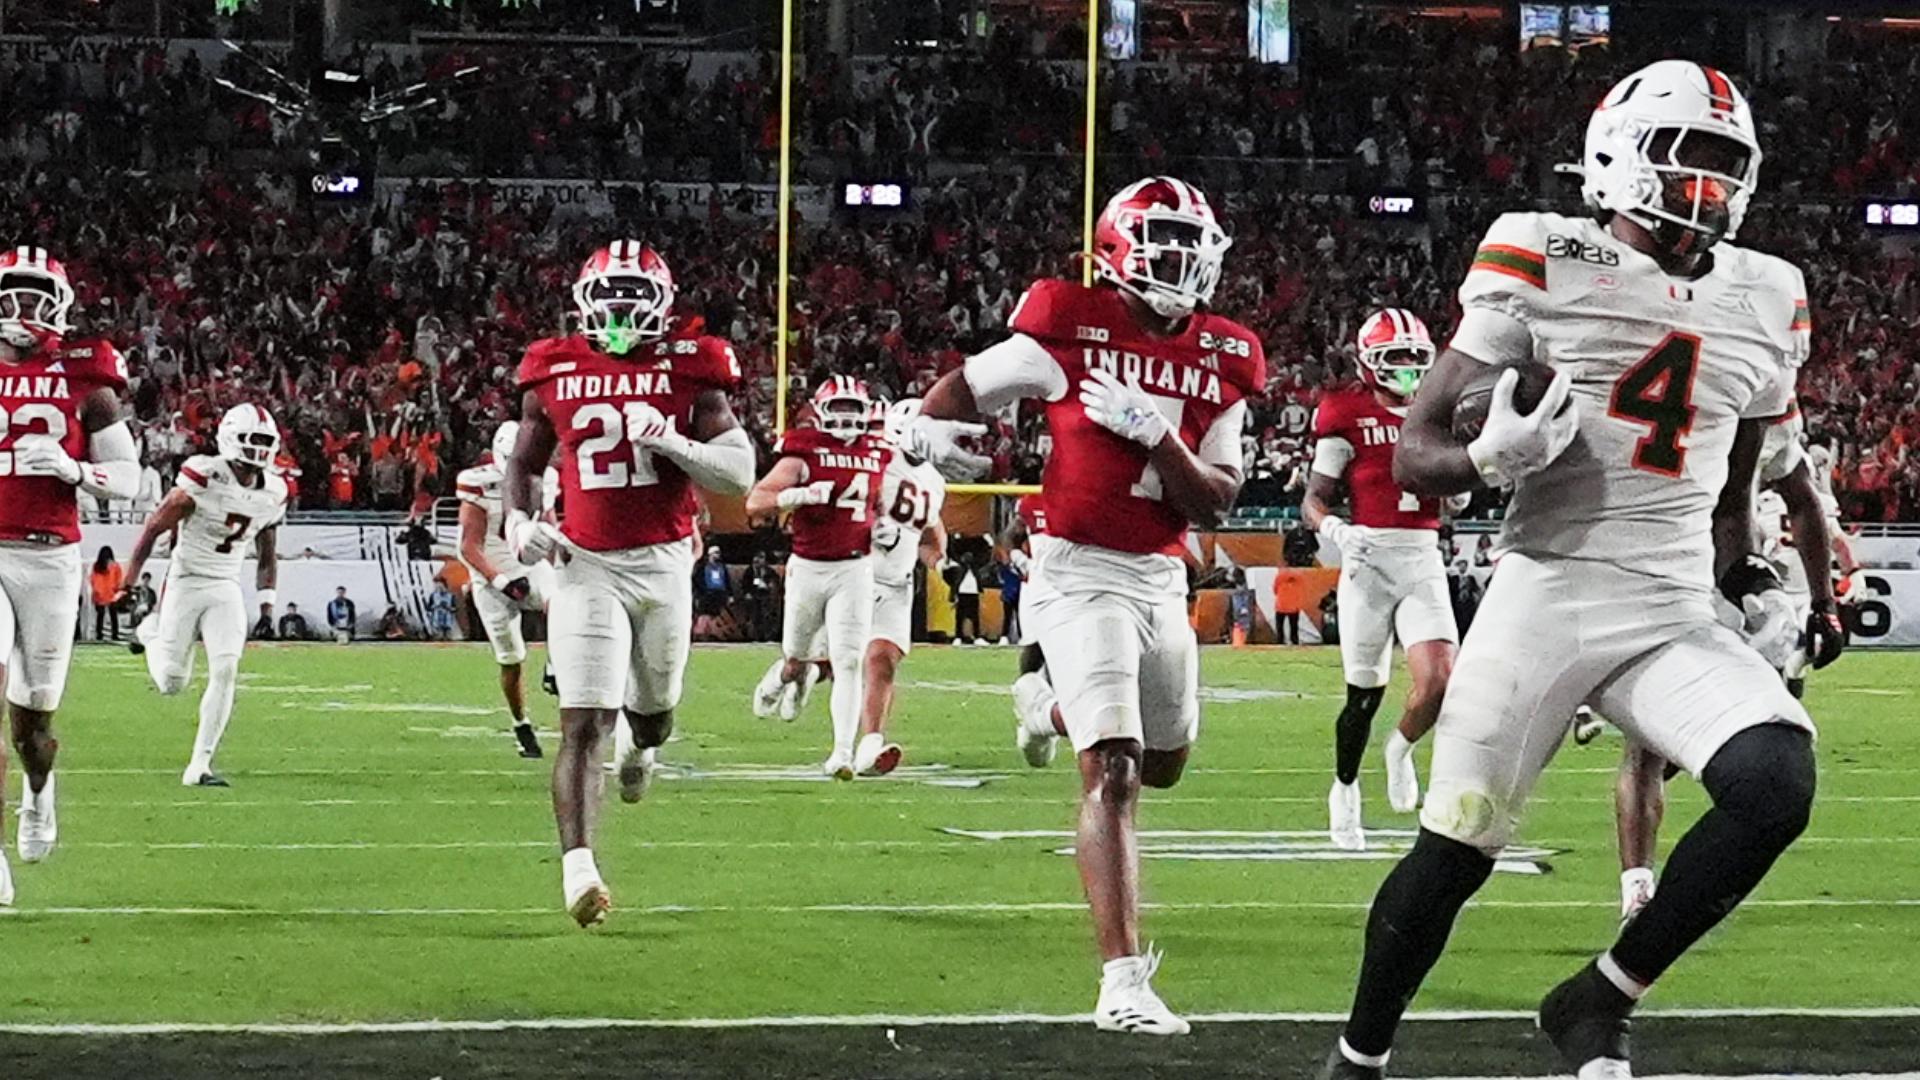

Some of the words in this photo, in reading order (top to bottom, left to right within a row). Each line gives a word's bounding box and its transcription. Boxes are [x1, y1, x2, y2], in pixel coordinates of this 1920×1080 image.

[556, 373, 672, 401] INDIANA
[1082, 348, 1222, 404] INDIANA
[1607, 331, 1703, 479] 4
[890, 479, 930, 531] 61
[214, 512, 254, 555] 7
